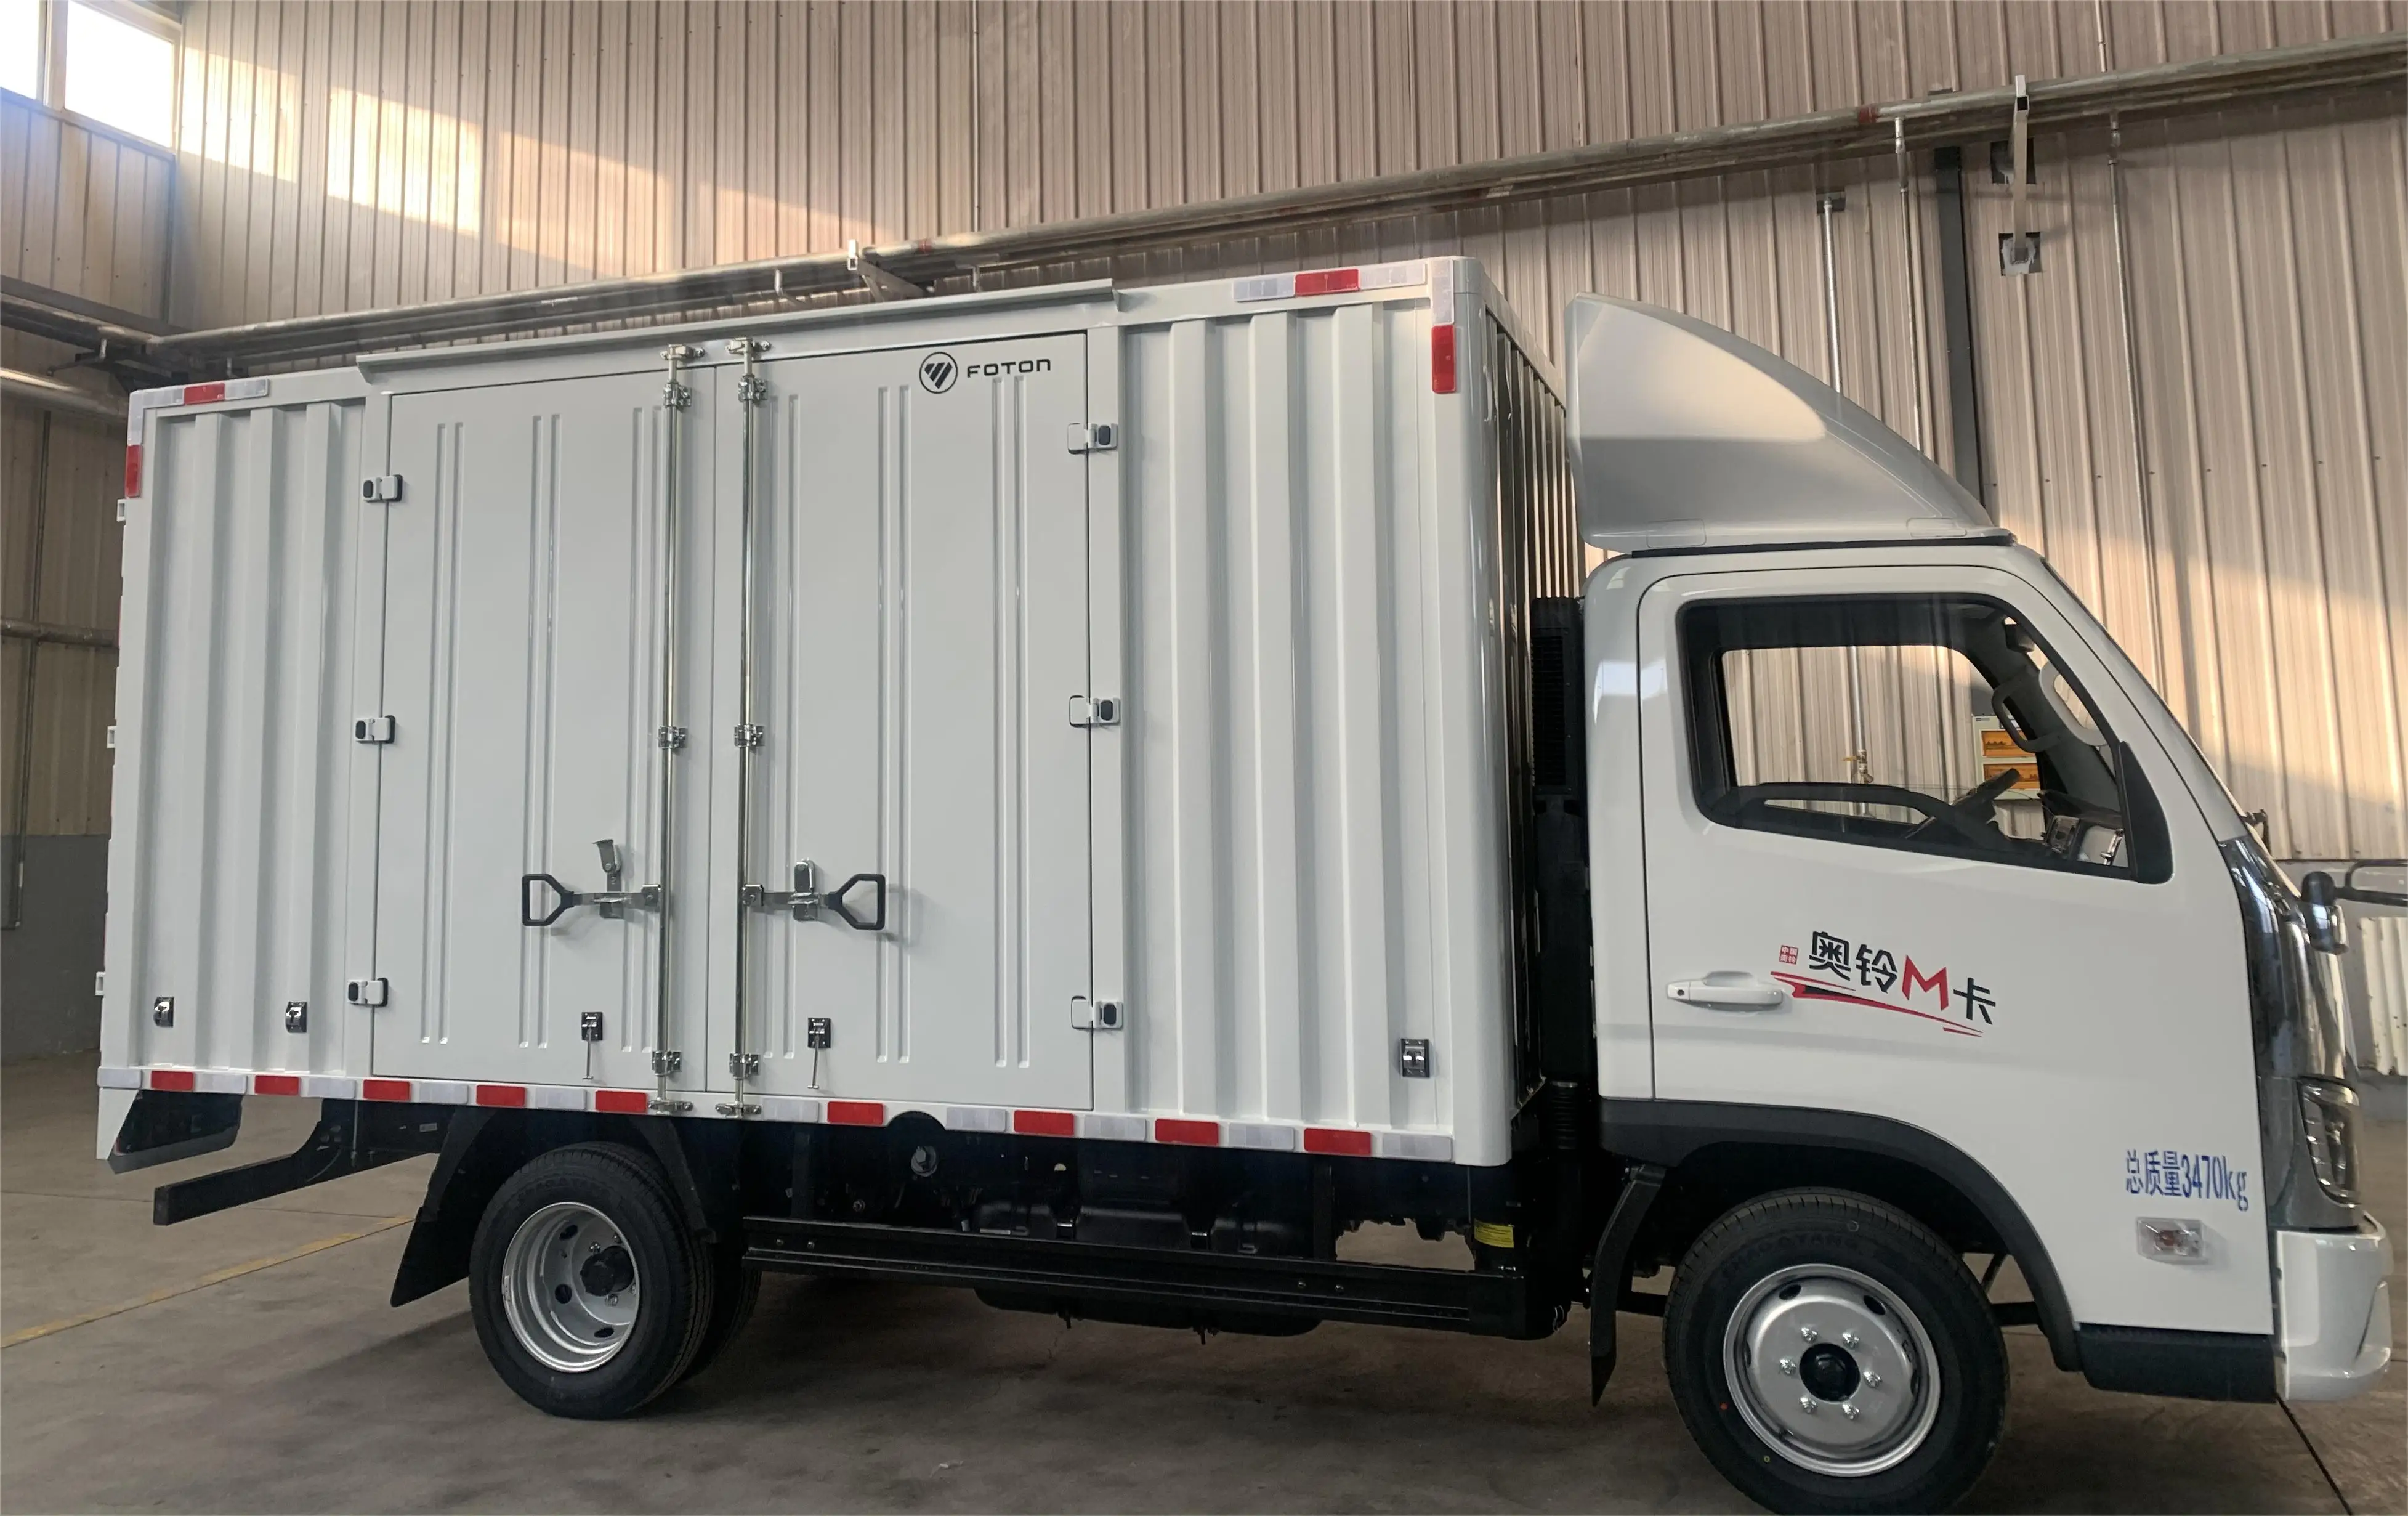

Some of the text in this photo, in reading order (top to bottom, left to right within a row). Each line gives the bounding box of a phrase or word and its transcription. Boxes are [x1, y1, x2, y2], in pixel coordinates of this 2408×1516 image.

[967, 359, 1051, 378] FOTON
[1809, 931, 1996, 1025] 奥铃M卡
[2126, 1149, 2249, 1212] 总质量3470kg
